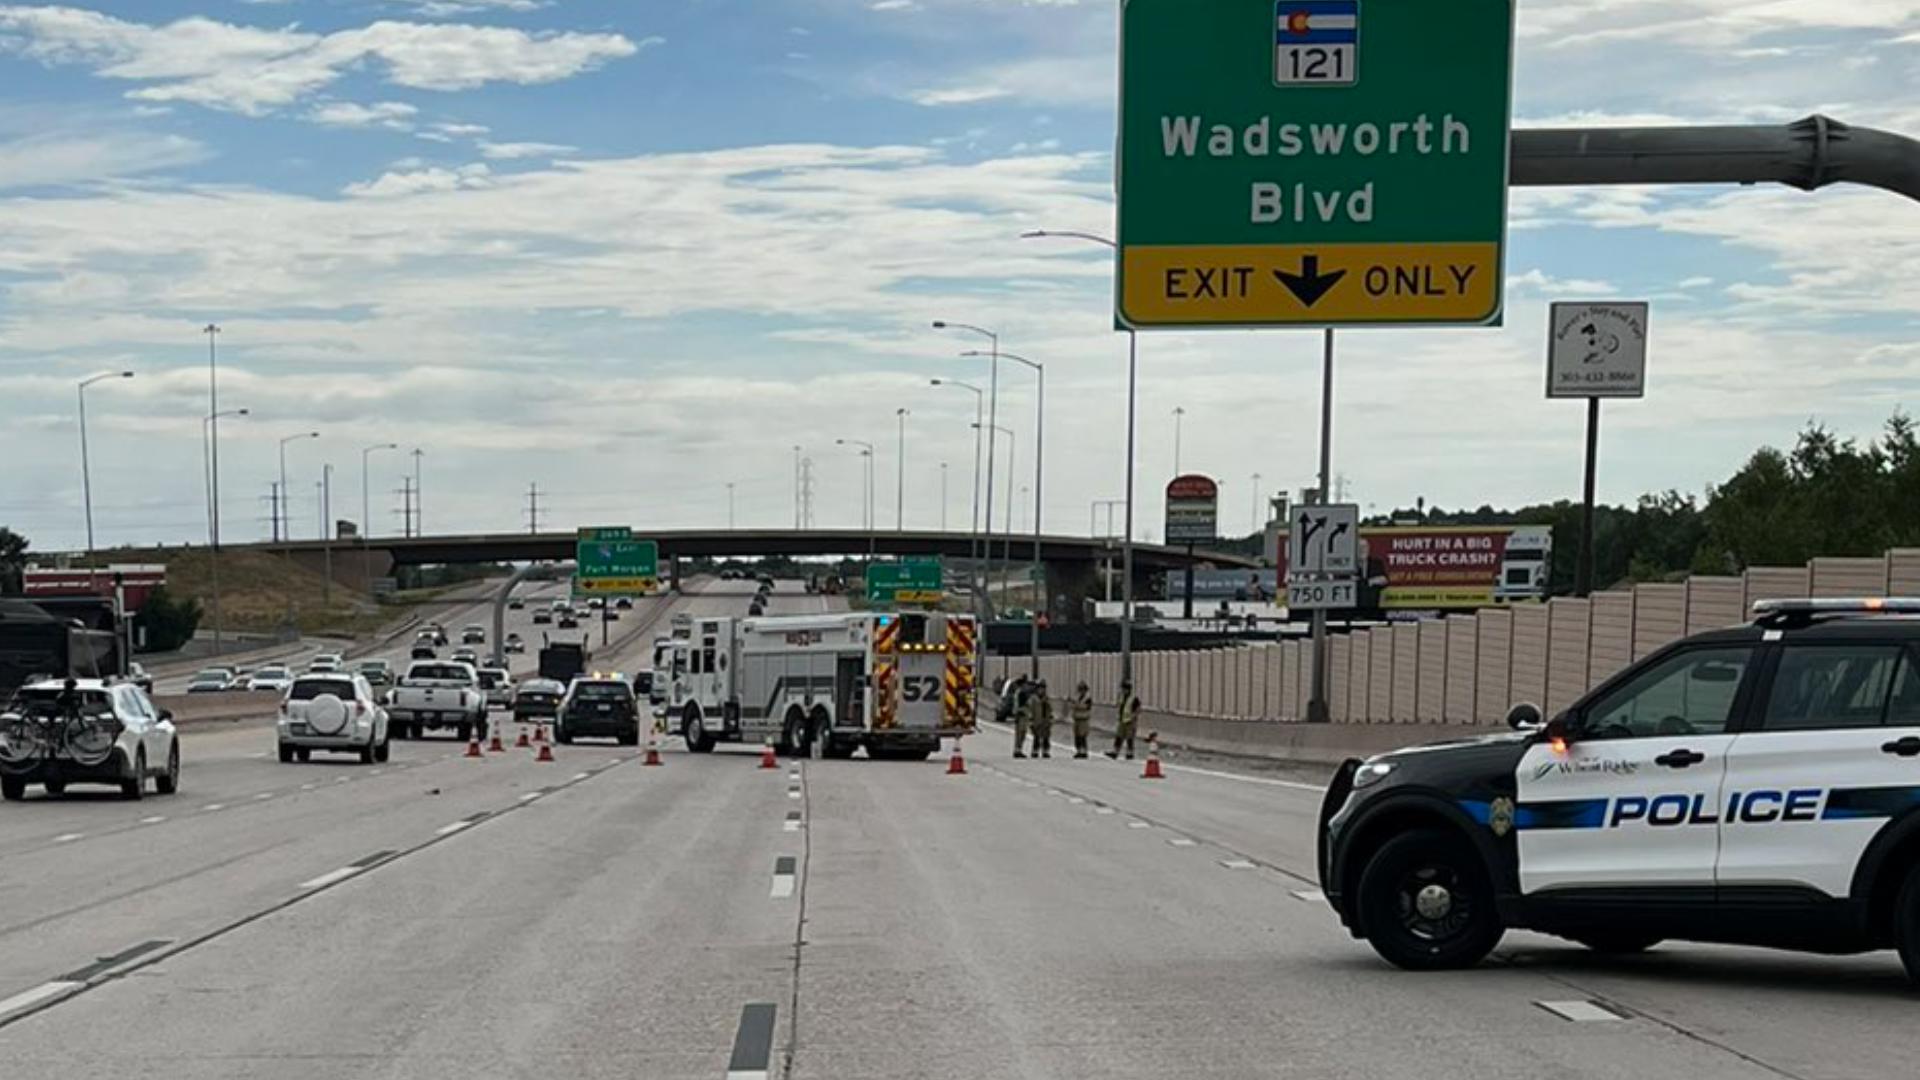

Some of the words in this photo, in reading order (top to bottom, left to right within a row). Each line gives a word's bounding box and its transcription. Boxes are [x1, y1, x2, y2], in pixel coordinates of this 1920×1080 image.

[1289, 48, 1343, 79] 121
[1161, 114, 1470, 156] Wadsworth
[1251, 182, 1374, 222] Blvd
[1165, 268, 1254, 298] EXIT
[1365, 265, 1476, 296] ONLY
[1388, 553, 1436, 565] TRUCK
[1439, 552, 1497, 564] CRASH?
[1392, 538, 1432, 550] HURT
[1435, 538, 1450, 549] IN
[1453, 538, 1464, 549] A
[1466, 537, 1493, 549] BIG
[1292, 586, 1324, 603] 750
[1332, 585, 1352, 602] FT
[903, 676, 941, 702] 52
[1610, 788, 1821, 828] POLICE
